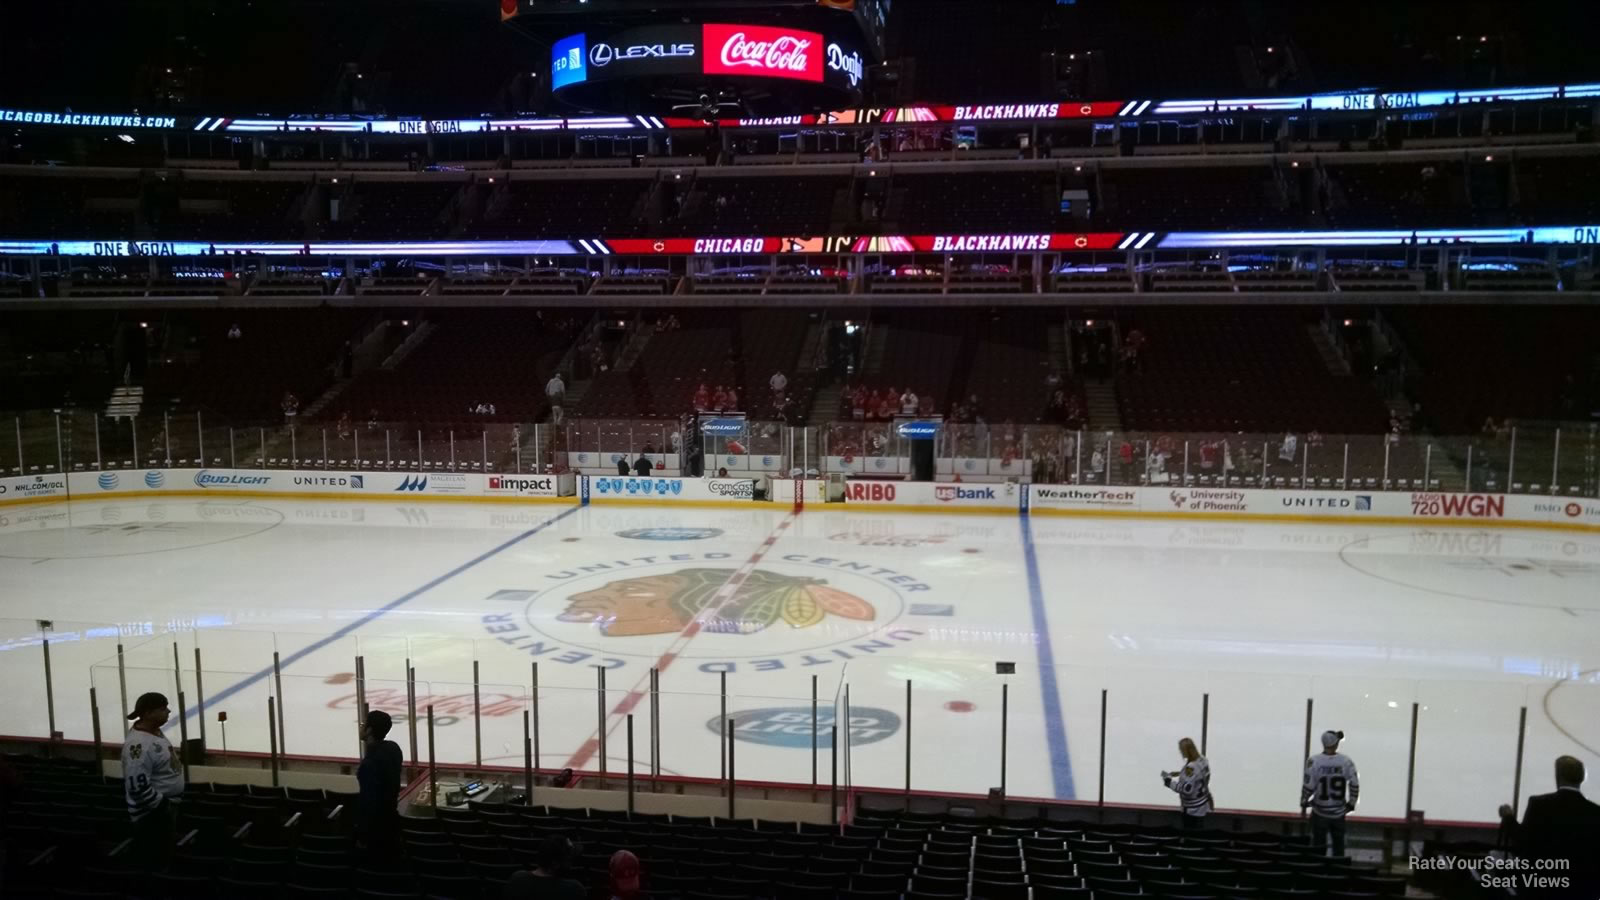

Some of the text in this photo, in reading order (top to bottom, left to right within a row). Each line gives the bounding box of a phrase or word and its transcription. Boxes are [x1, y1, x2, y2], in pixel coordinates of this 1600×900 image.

[615, 44, 695, 59] LEXUS
[721, 32, 811, 71] Coca-Cola
[1343, 92, 1419, 109] ONE GOAL
[953, 104, 1059, 120] BLACKHAWKS
[399, 120, 461, 133] ONE GOAL
[93, 242, 176, 256] ONE GOAL
[694, 235, 1050, 253] CHICAGO BLACKHAWKS
[15, 481, 65, 491] NHL.COM/GCL
[200, 475, 271, 485] BUD LIGHT
[294, 477, 347, 486] UNITED
[500, 475, 552, 492] impact
[1037, 489, 1135, 500] WeatherTech
[1190, 491, 1245, 503] University
[1190, 501, 1247, 511] of Phoenix
[1282, 498, 1350, 508] UNITED
[1412, 494, 1505, 518] 720 WGN
[544, 551, 932, 592] UNITED CENTER
[481, 611, 925, 674] UNITED CENTER
[128, 773, 148, 791] 19
[1319, 775, 1346, 801] 19
